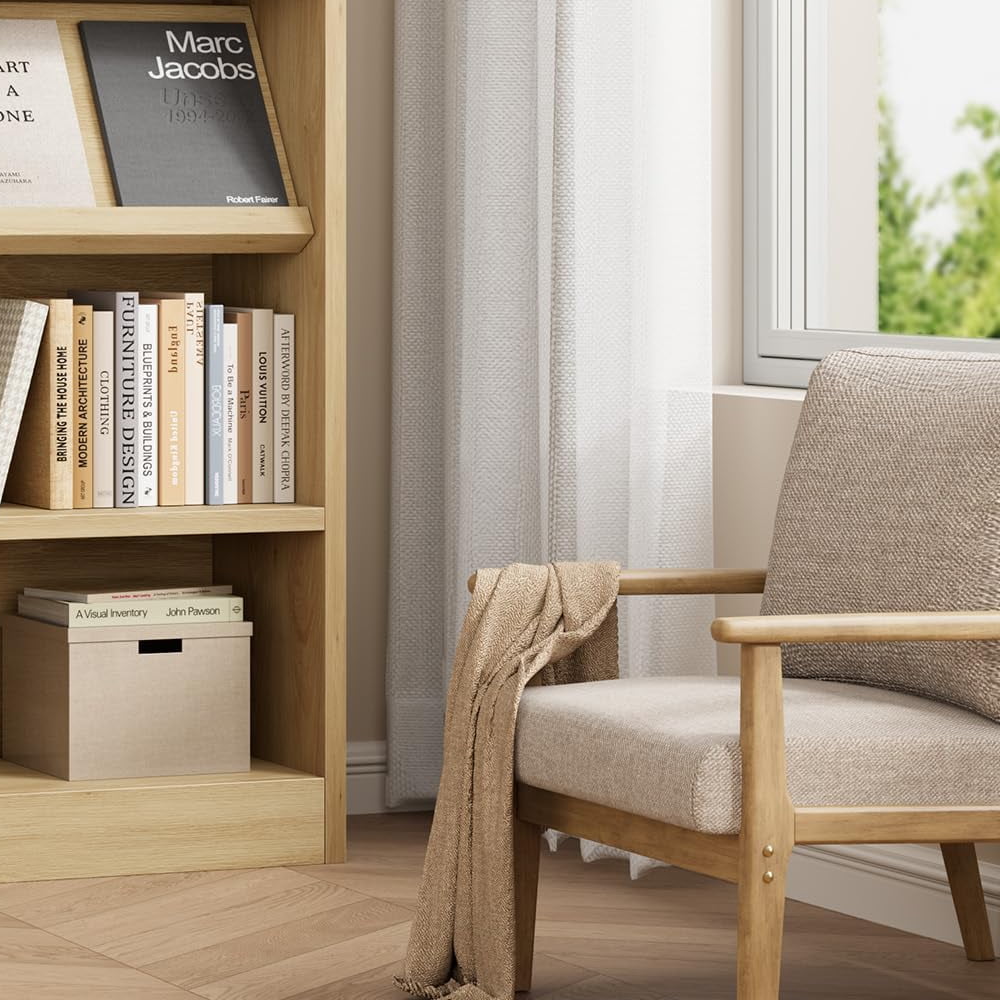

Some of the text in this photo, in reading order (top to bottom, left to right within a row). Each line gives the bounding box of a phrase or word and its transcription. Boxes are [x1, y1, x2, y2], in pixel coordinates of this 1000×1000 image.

[165, 30, 244, 54] Marc
[148, 56, 256, 80] Jacobs
[6, 84, 20, 97] A
[226, 195, 254, 204] Robert
[143, 343, 153, 408] BLUEPRINTS
[227, 364, 234, 373] To
[227, 376, 234, 387] Be
[100, 370, 109, 435] CLOTHING
[122, 296, 135, 504] FURNITURE DESIGN
[259, 352, 267, 424] LOUIS VUITTON
[56, 346, 67, 462] BRINGING THE HOUSE HOME
[78, 339, 88, 468] MODERN ARCHITECTURE
[240, 390, 250, 419] Paris
[281, 328, 290, 490] AFTERWORD BY DEEPAK CHOPRA
[143, 421, 153, 477] BUILDINGS
[76, 609, 148, 619] A Visual Inventory
[166, 607, 220, 616] John Pawson
